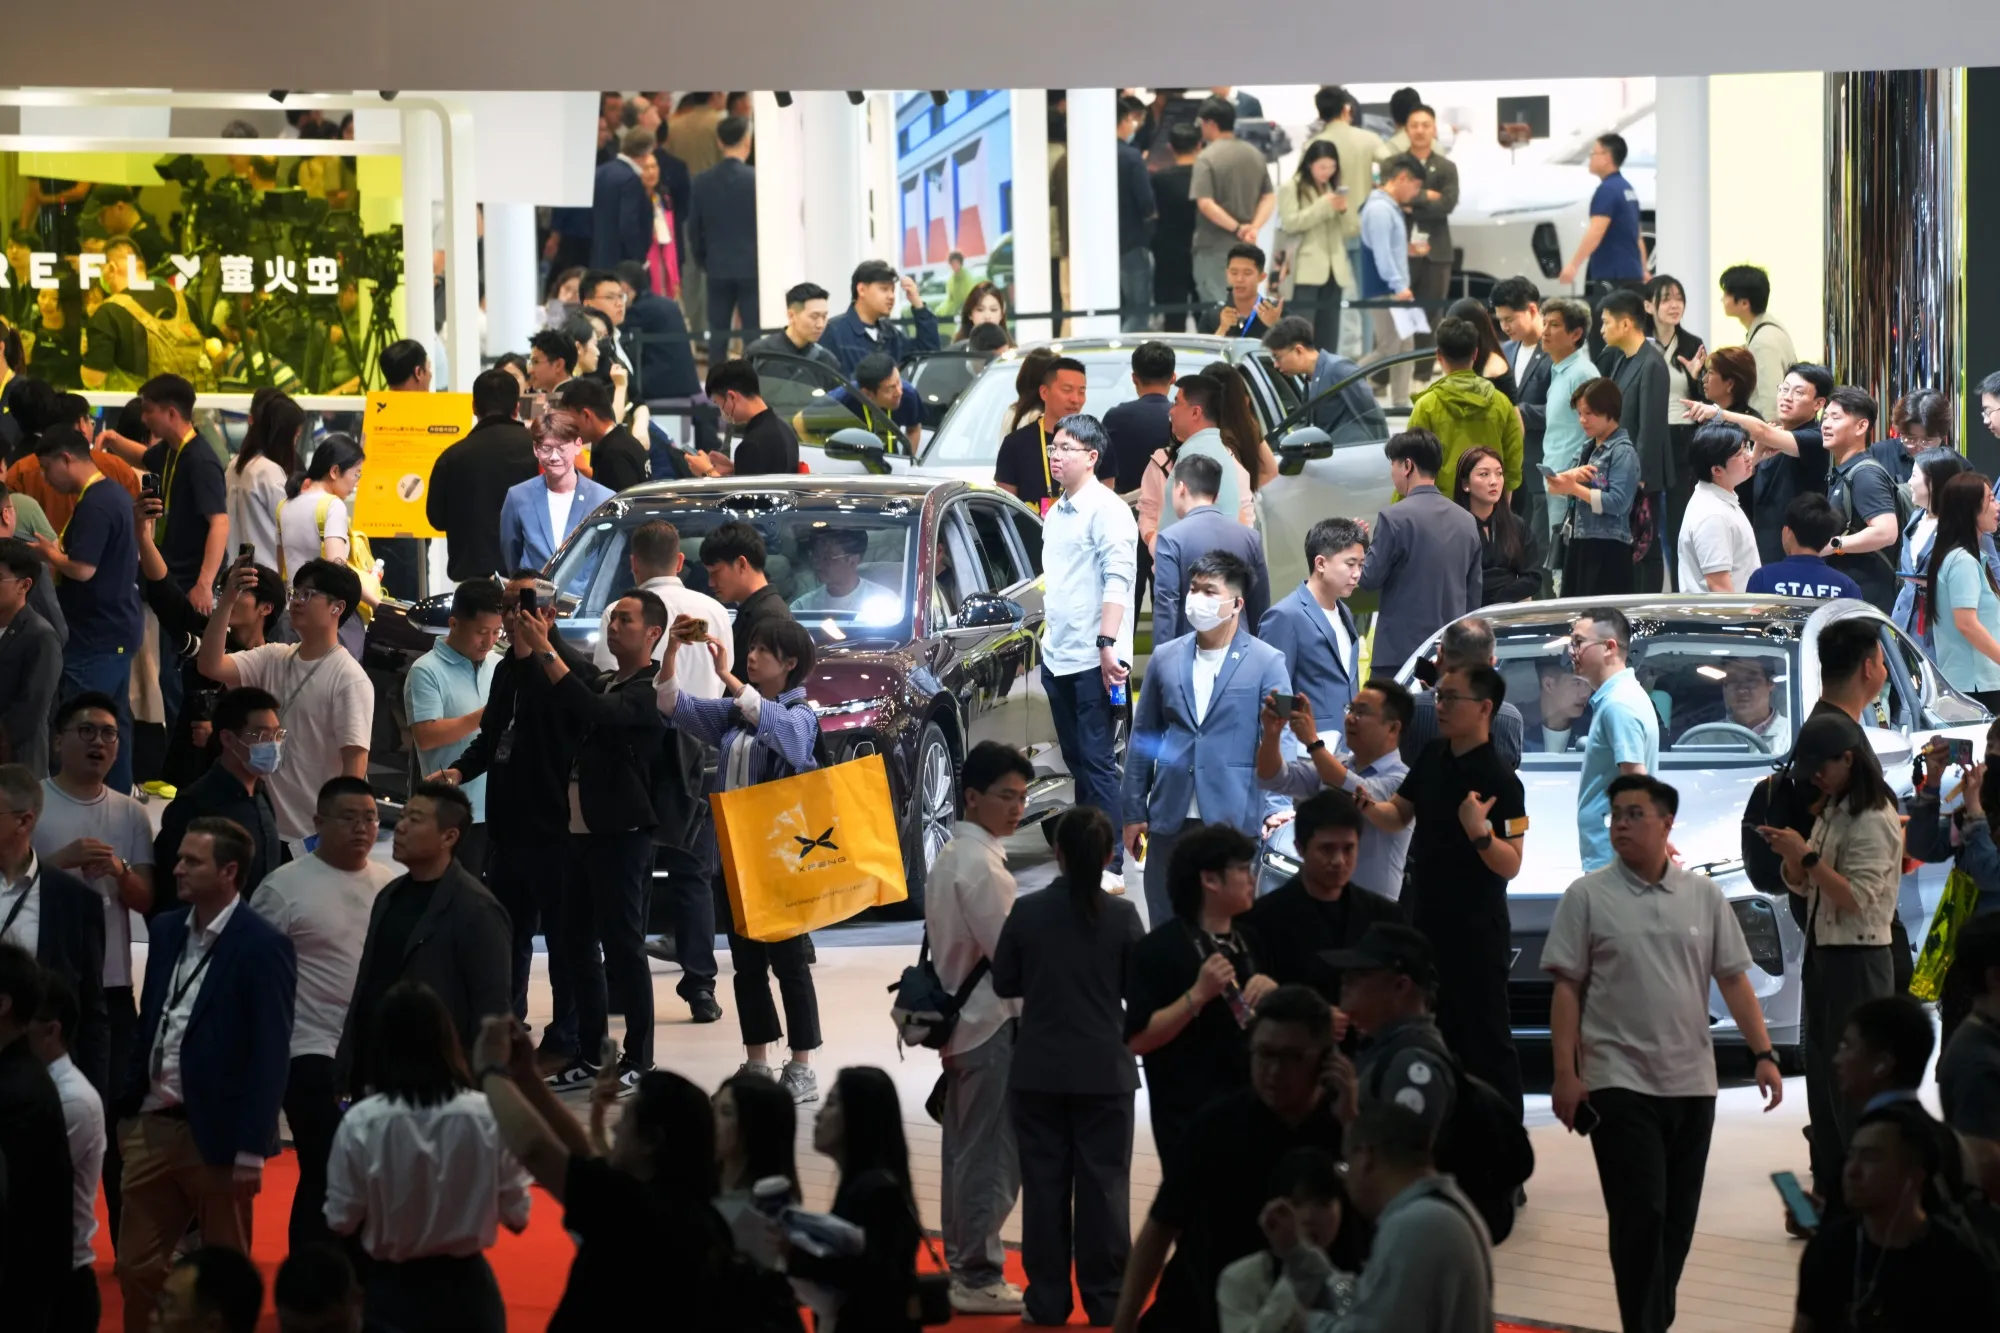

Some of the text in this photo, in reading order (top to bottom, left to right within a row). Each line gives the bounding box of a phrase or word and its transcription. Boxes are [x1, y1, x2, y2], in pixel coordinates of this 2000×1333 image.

[220, 254, 339, 294] 萤火虫
[1774, 582, 1842, 598] STAFF
[798, 856, 847, 873] XPENG
